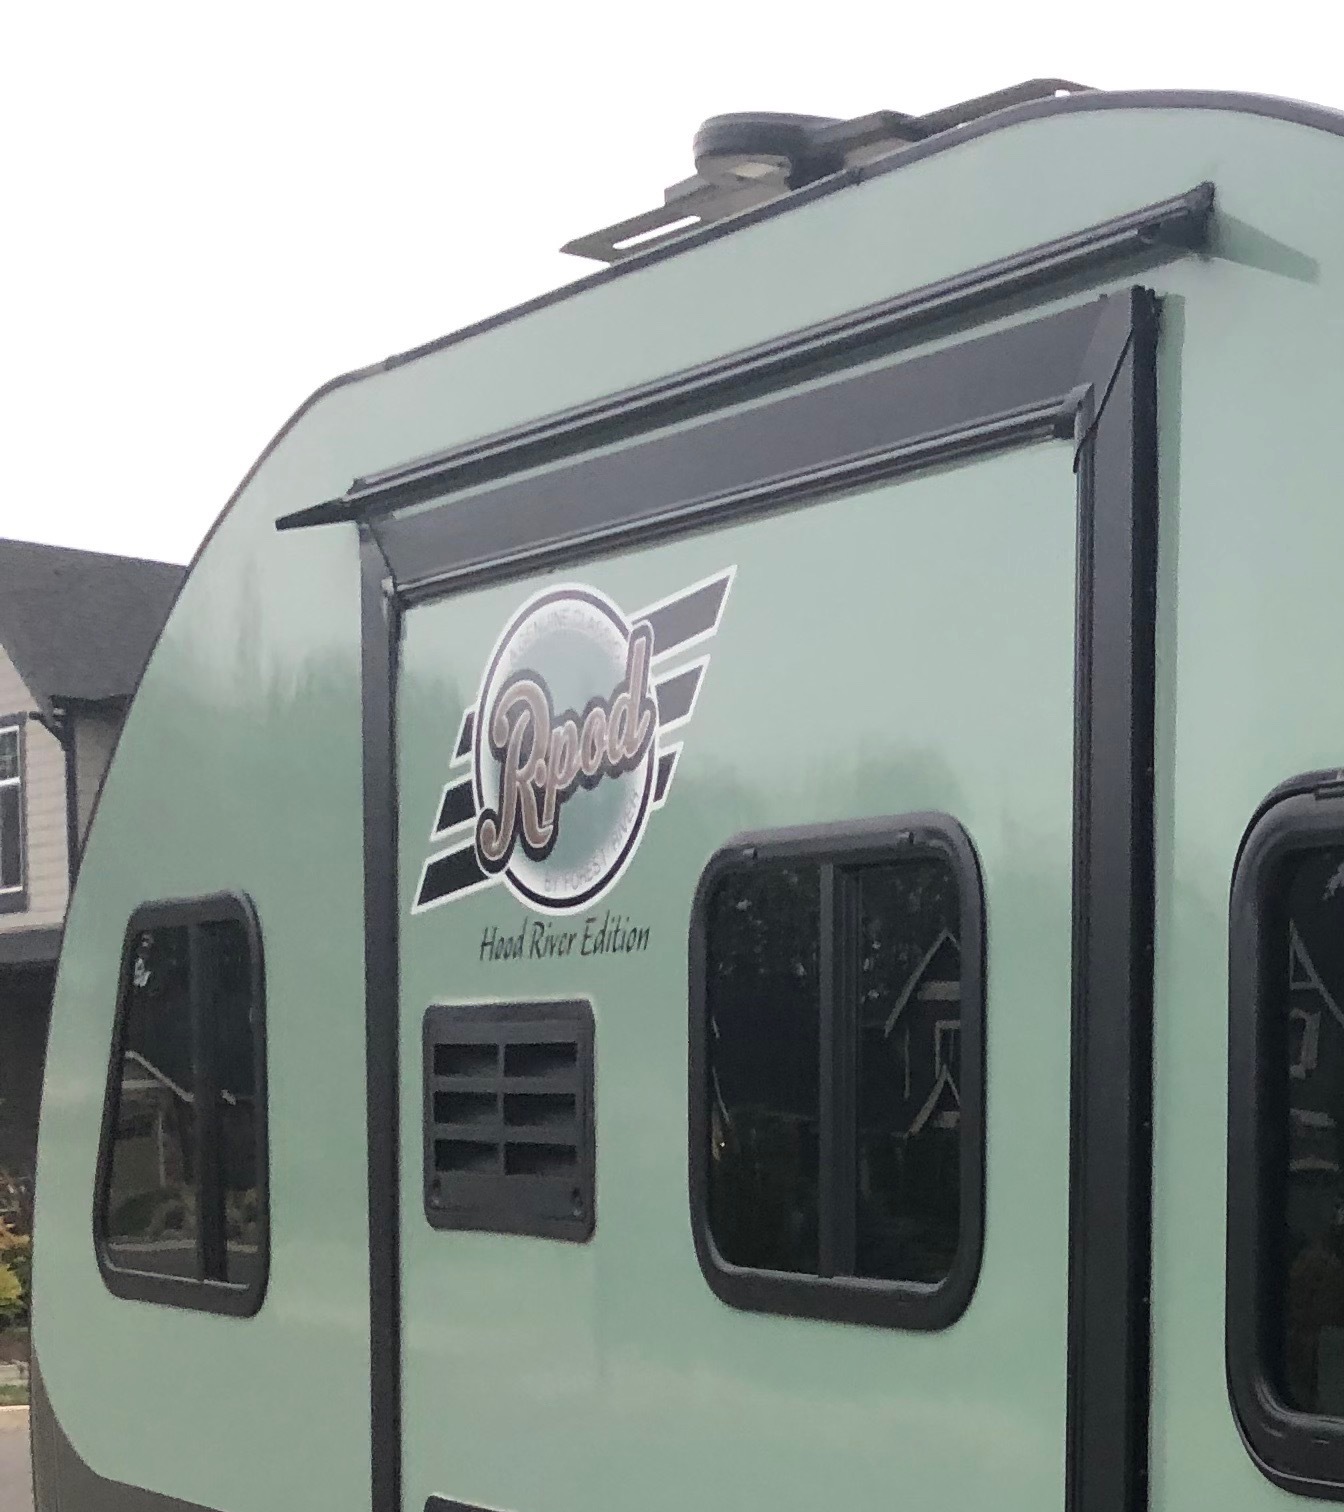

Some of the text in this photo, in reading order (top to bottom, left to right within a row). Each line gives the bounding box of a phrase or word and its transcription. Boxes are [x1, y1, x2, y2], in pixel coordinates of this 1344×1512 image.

[479, 910, 650, 961] Hood River Edition
